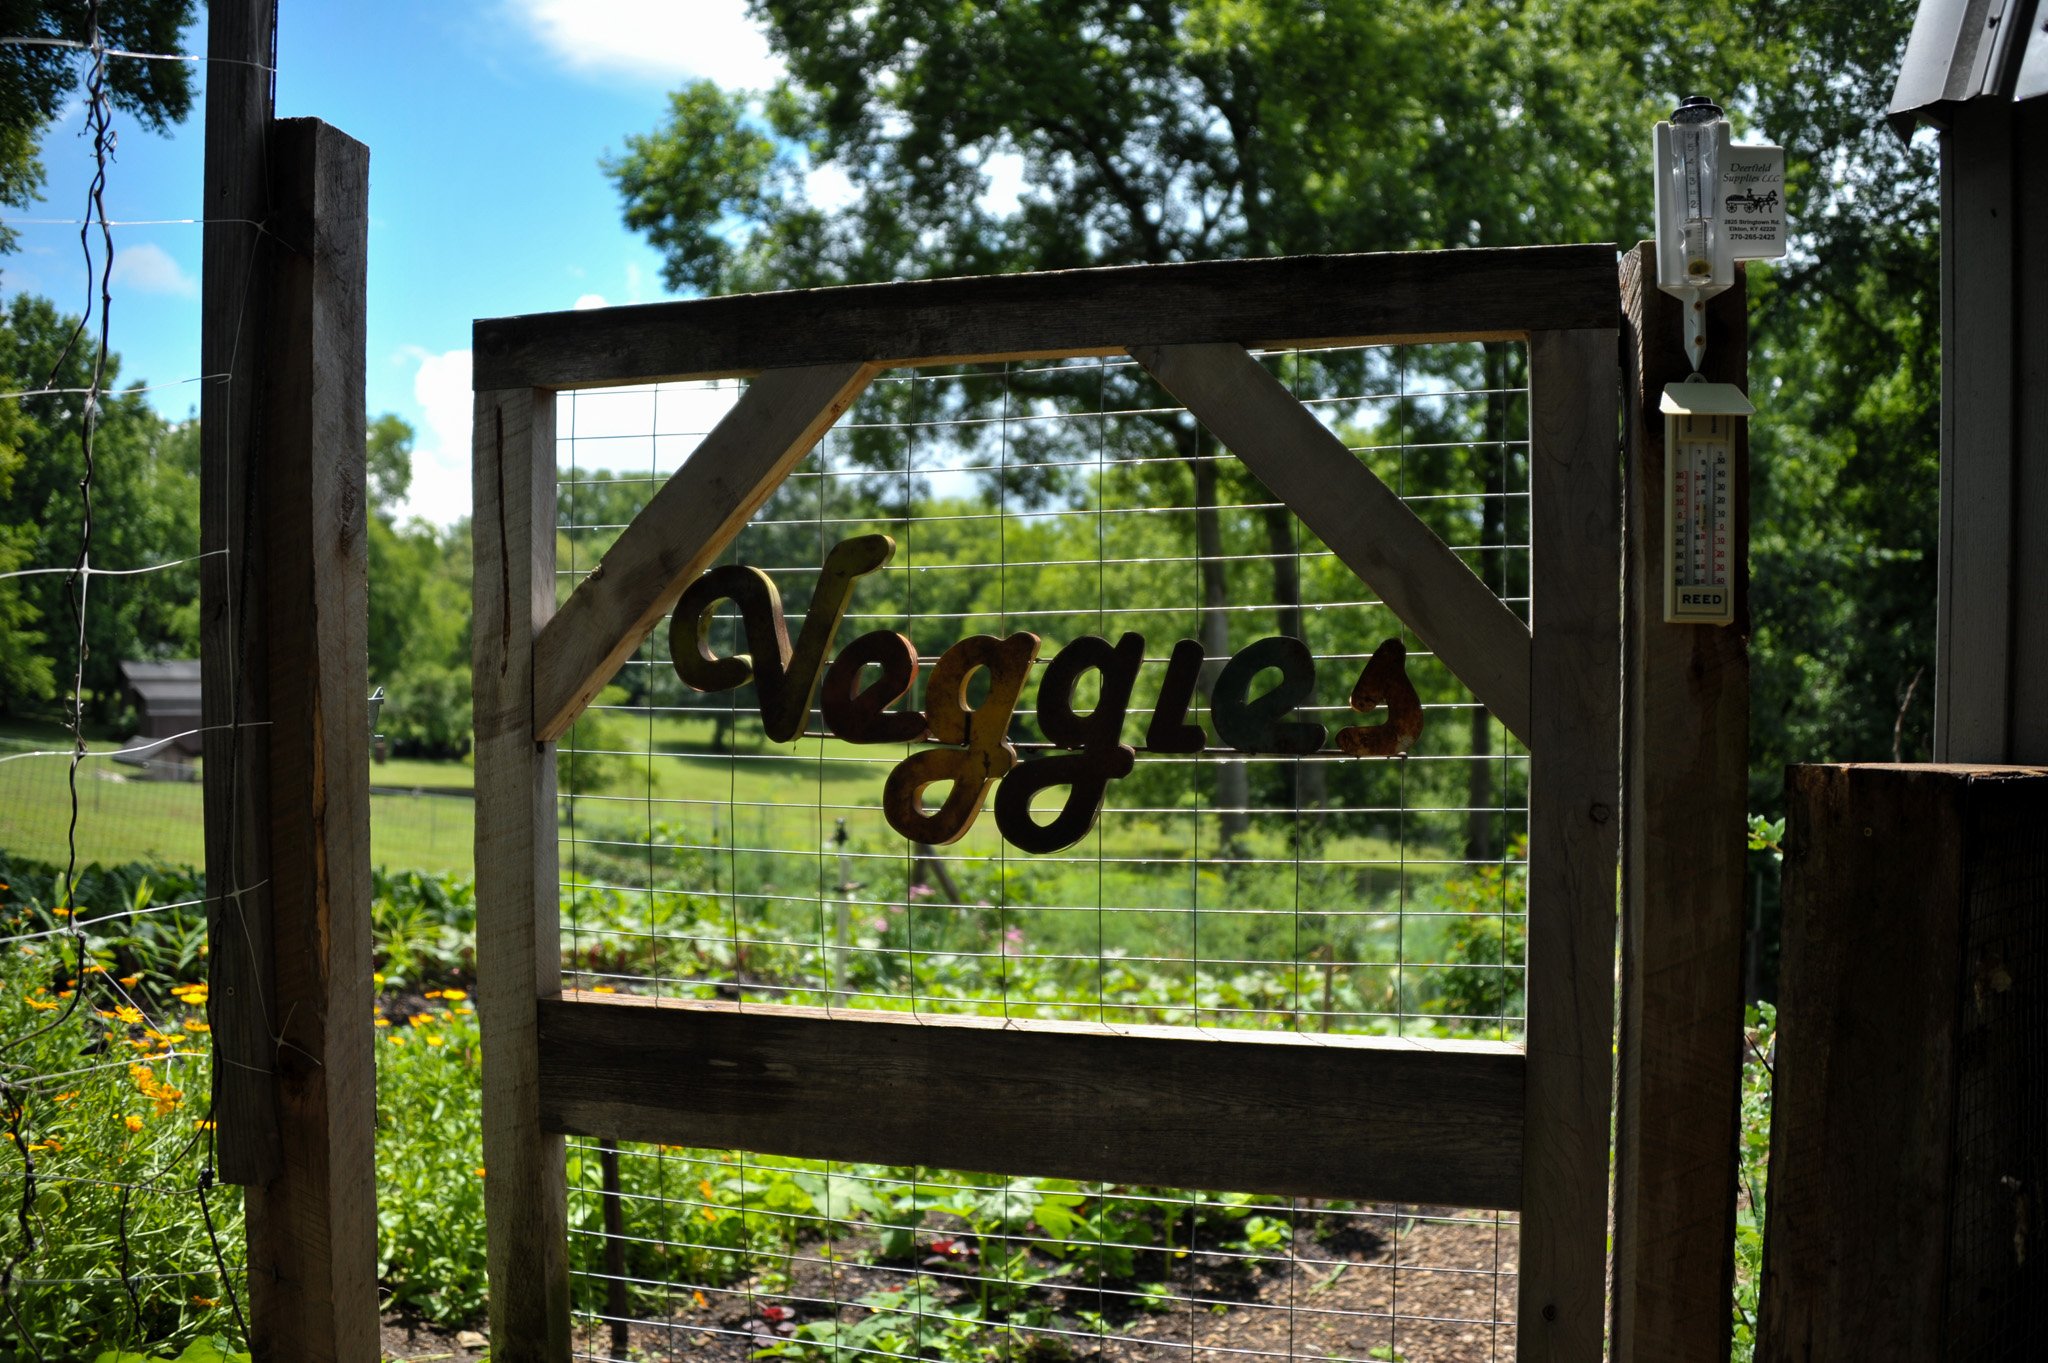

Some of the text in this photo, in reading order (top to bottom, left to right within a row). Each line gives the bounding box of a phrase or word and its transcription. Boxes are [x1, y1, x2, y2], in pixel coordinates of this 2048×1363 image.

[1730, 163, 1772, 173] Deerfield
[1689, 177, 1695, 185] 3
[1723, 174, 1760, 184] Supplies
[1690, 200, 1697, 208] 2
[1682, 594, 1722, 604] REED
[669, 534, 1423, 854] Veggies
